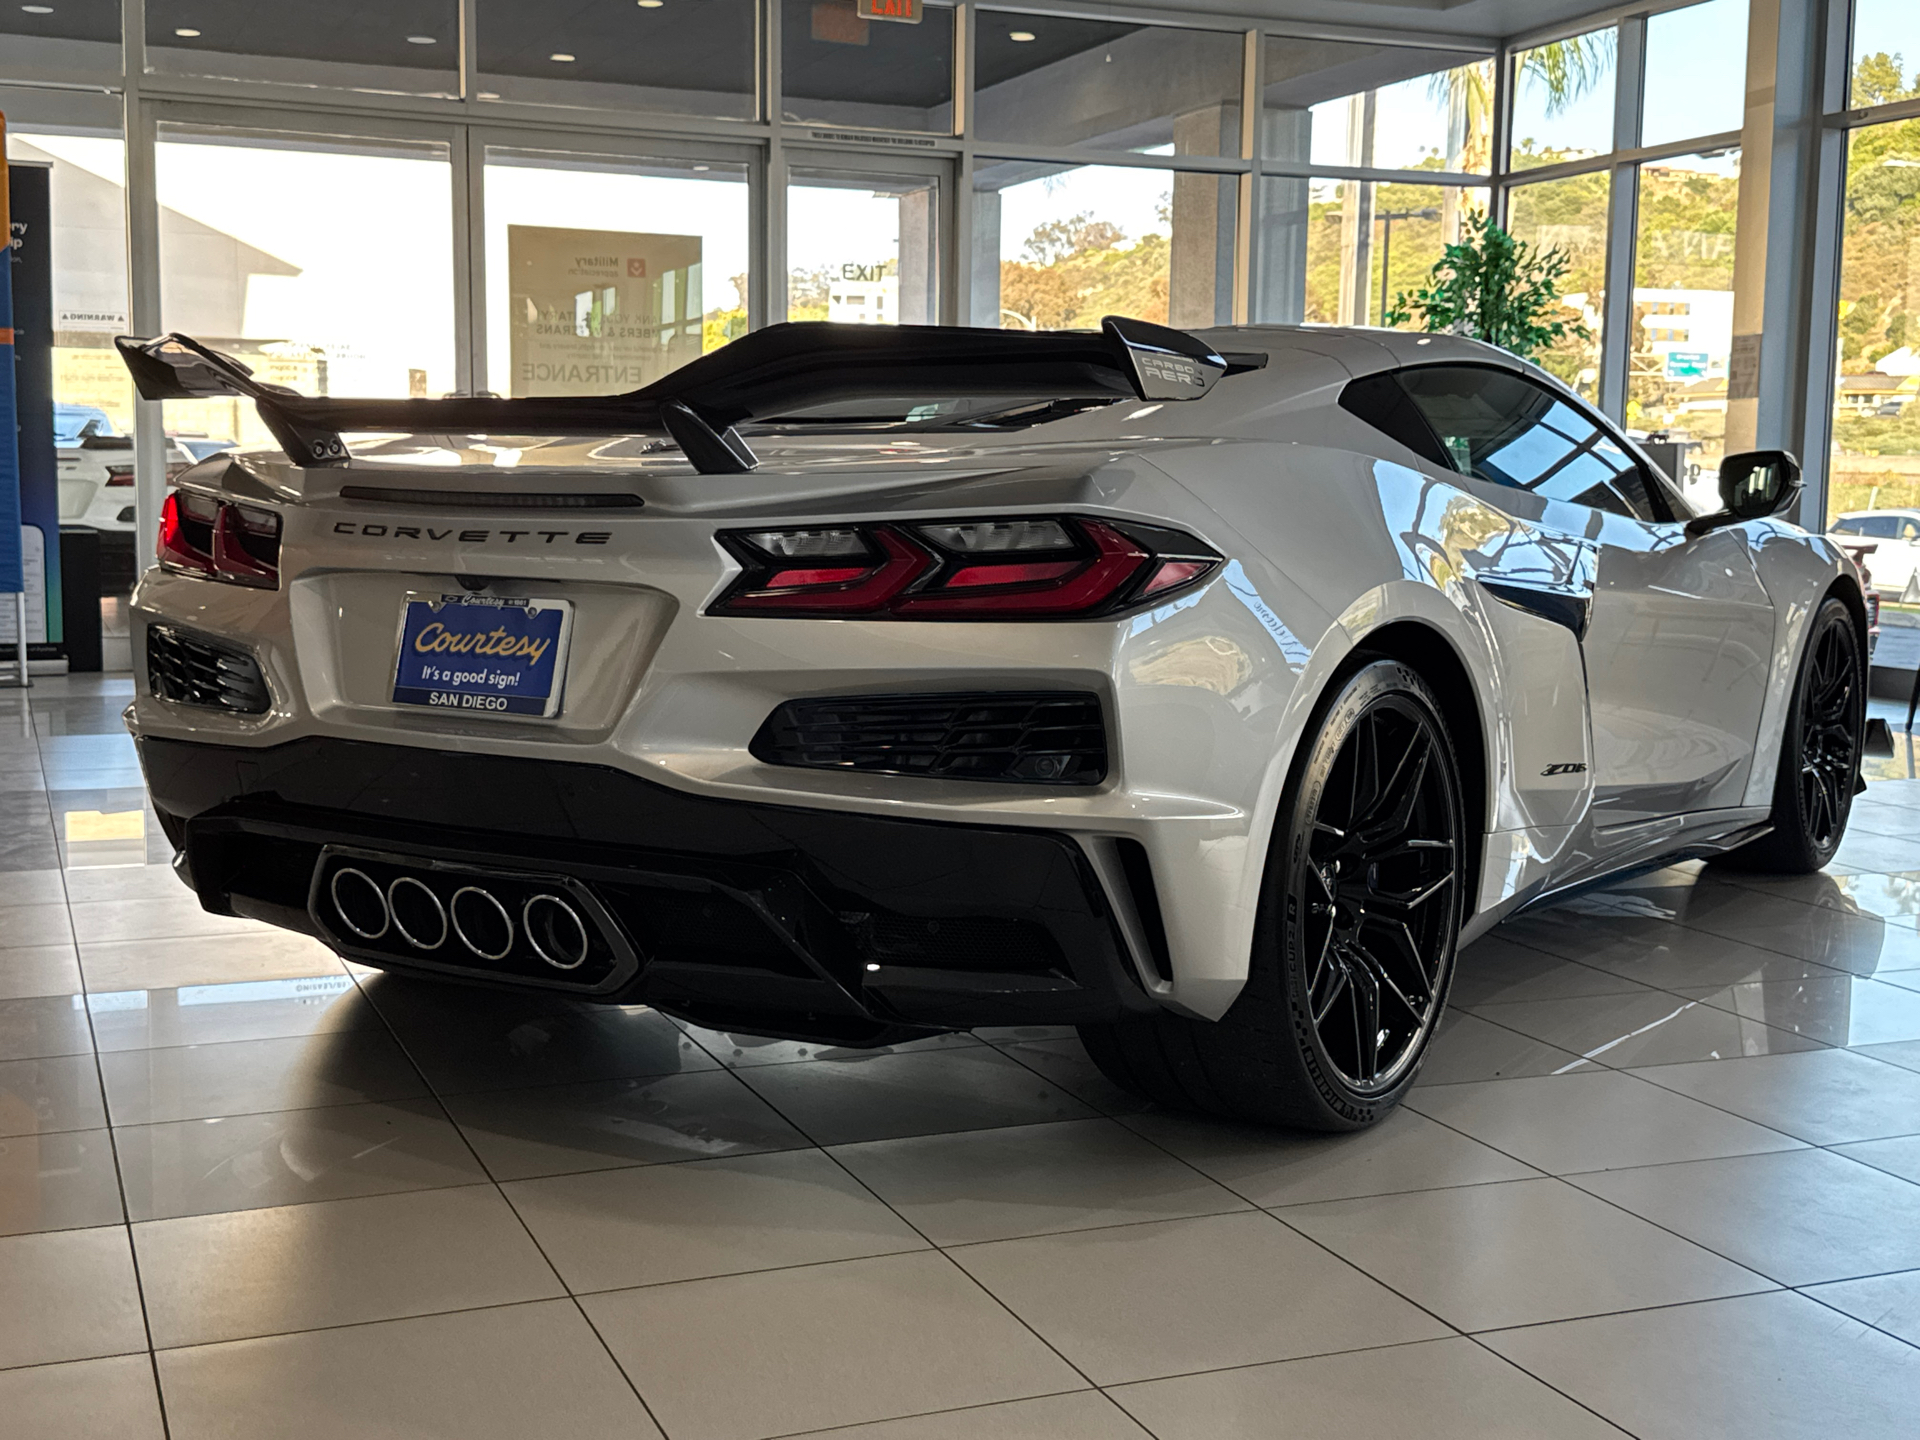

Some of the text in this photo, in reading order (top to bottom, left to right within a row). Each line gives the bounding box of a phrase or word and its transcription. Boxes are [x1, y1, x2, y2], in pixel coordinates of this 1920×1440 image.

[843, 263, 887, 281] EXIT
[333, 521, 613, 545] CORVETTE
[415, 622, 551, 666] Courtesy
[421, 665, 521, 689] It's a good sign!
[429, 692, 508, 711] SAN DIEGO
[1540, 763, 1587, 776] Z06
[1304, 1050, 1344, 1111] MICHELIN
